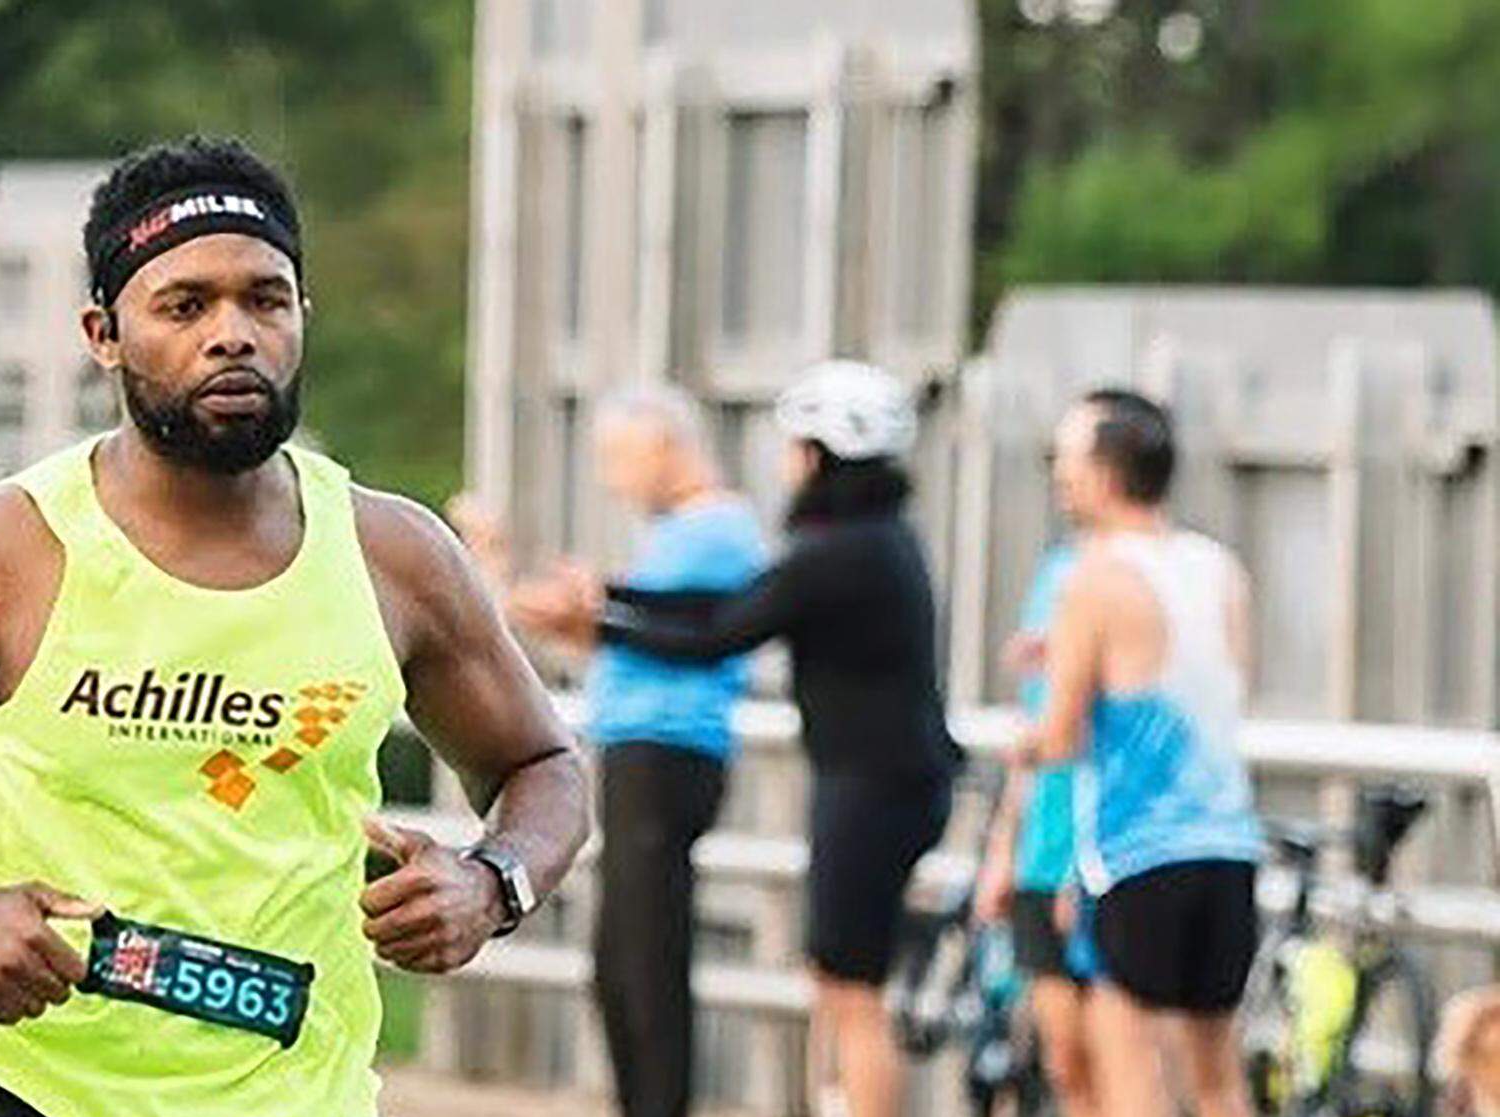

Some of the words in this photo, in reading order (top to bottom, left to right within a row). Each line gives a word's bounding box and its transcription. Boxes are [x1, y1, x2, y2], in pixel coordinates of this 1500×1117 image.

[60, 669, 285, 729] Achilles
[108, 723, 275, 747] INTERNATIONAL
[173, 960, 291, 1025] 5963
